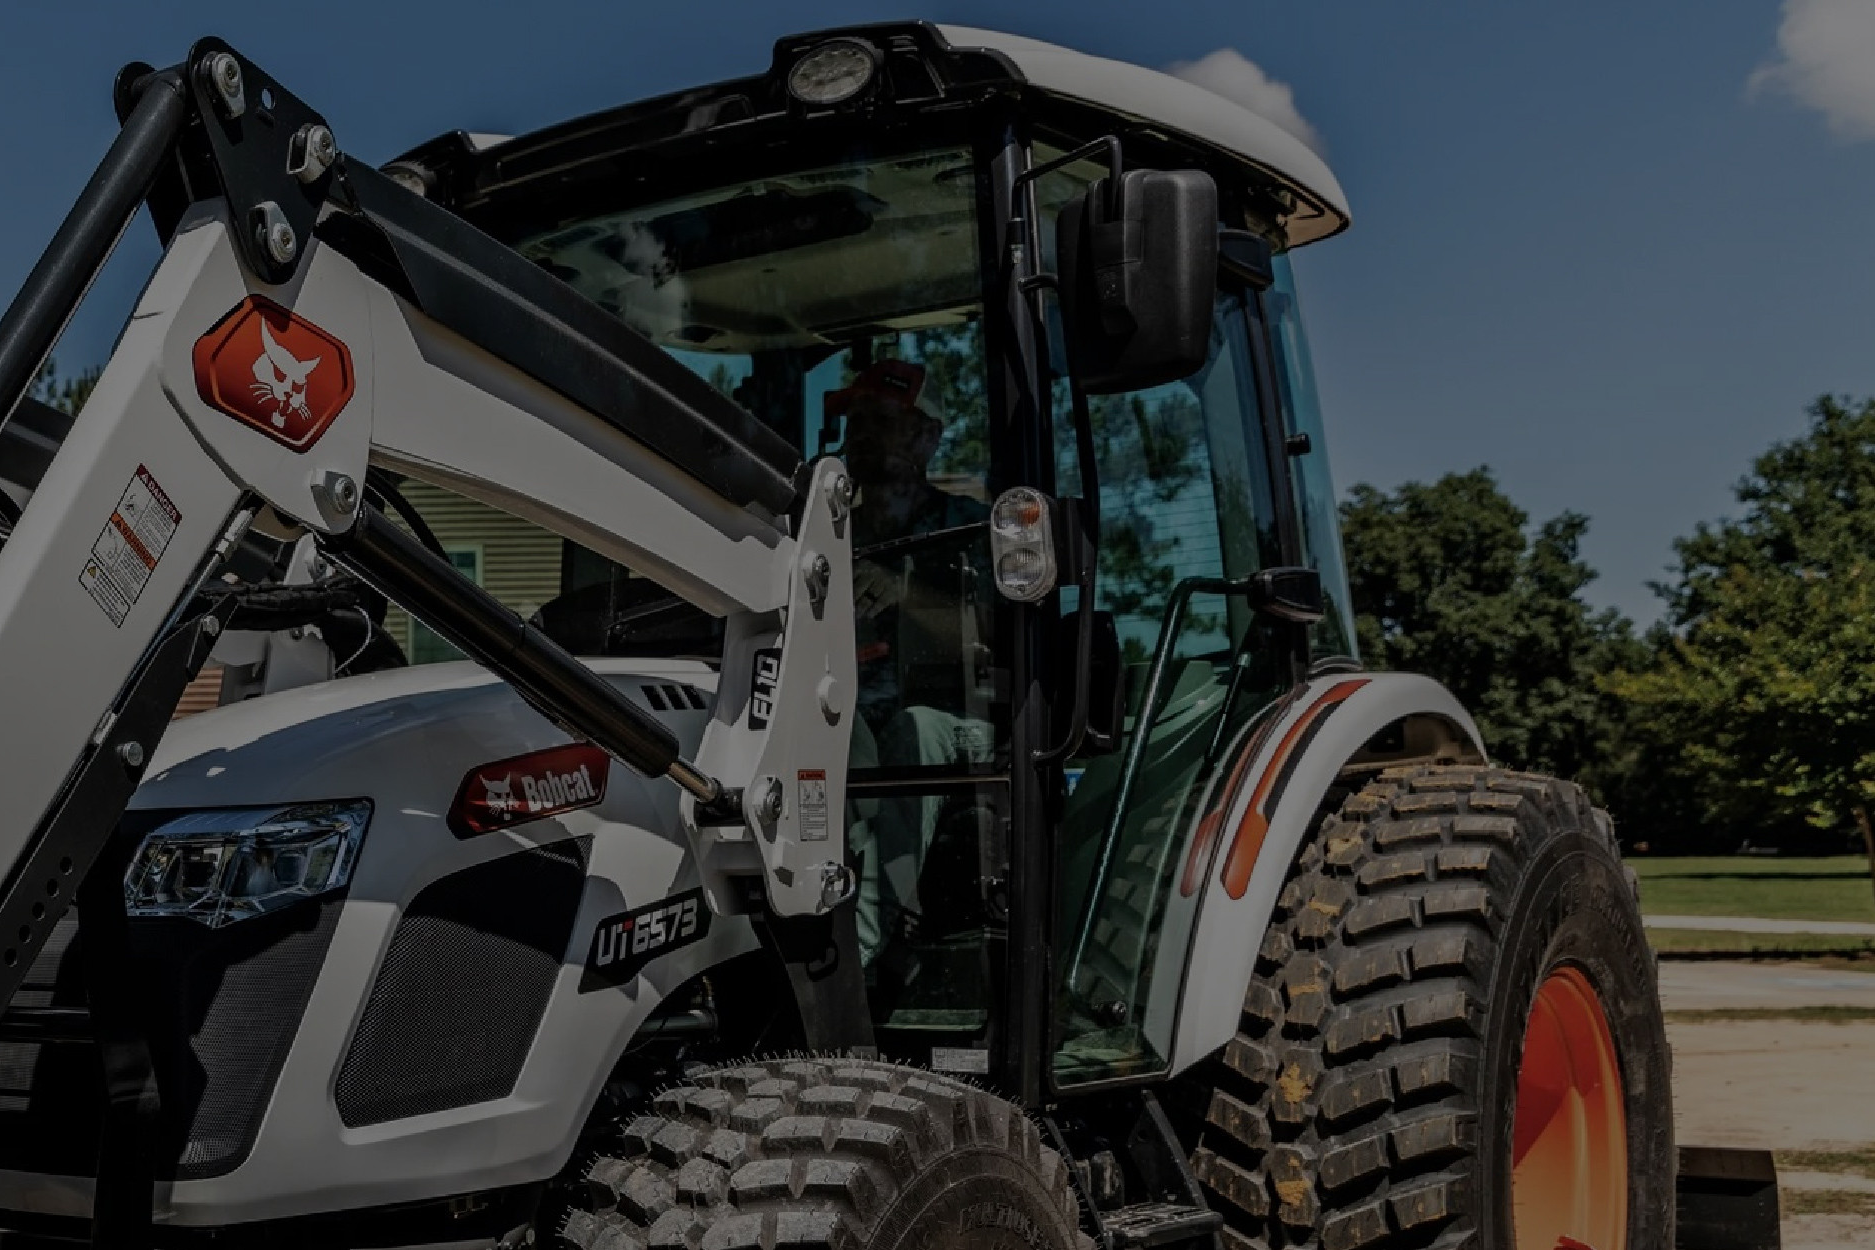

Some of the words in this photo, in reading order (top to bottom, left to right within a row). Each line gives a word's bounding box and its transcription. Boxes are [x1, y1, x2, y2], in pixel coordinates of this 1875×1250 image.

[147, 480, 177, 520] DANGER
[753, 654, 777, 719] EL10
[521, 764, 596, 812] Bobcat
[598, 897, 697, 966] UT6573
